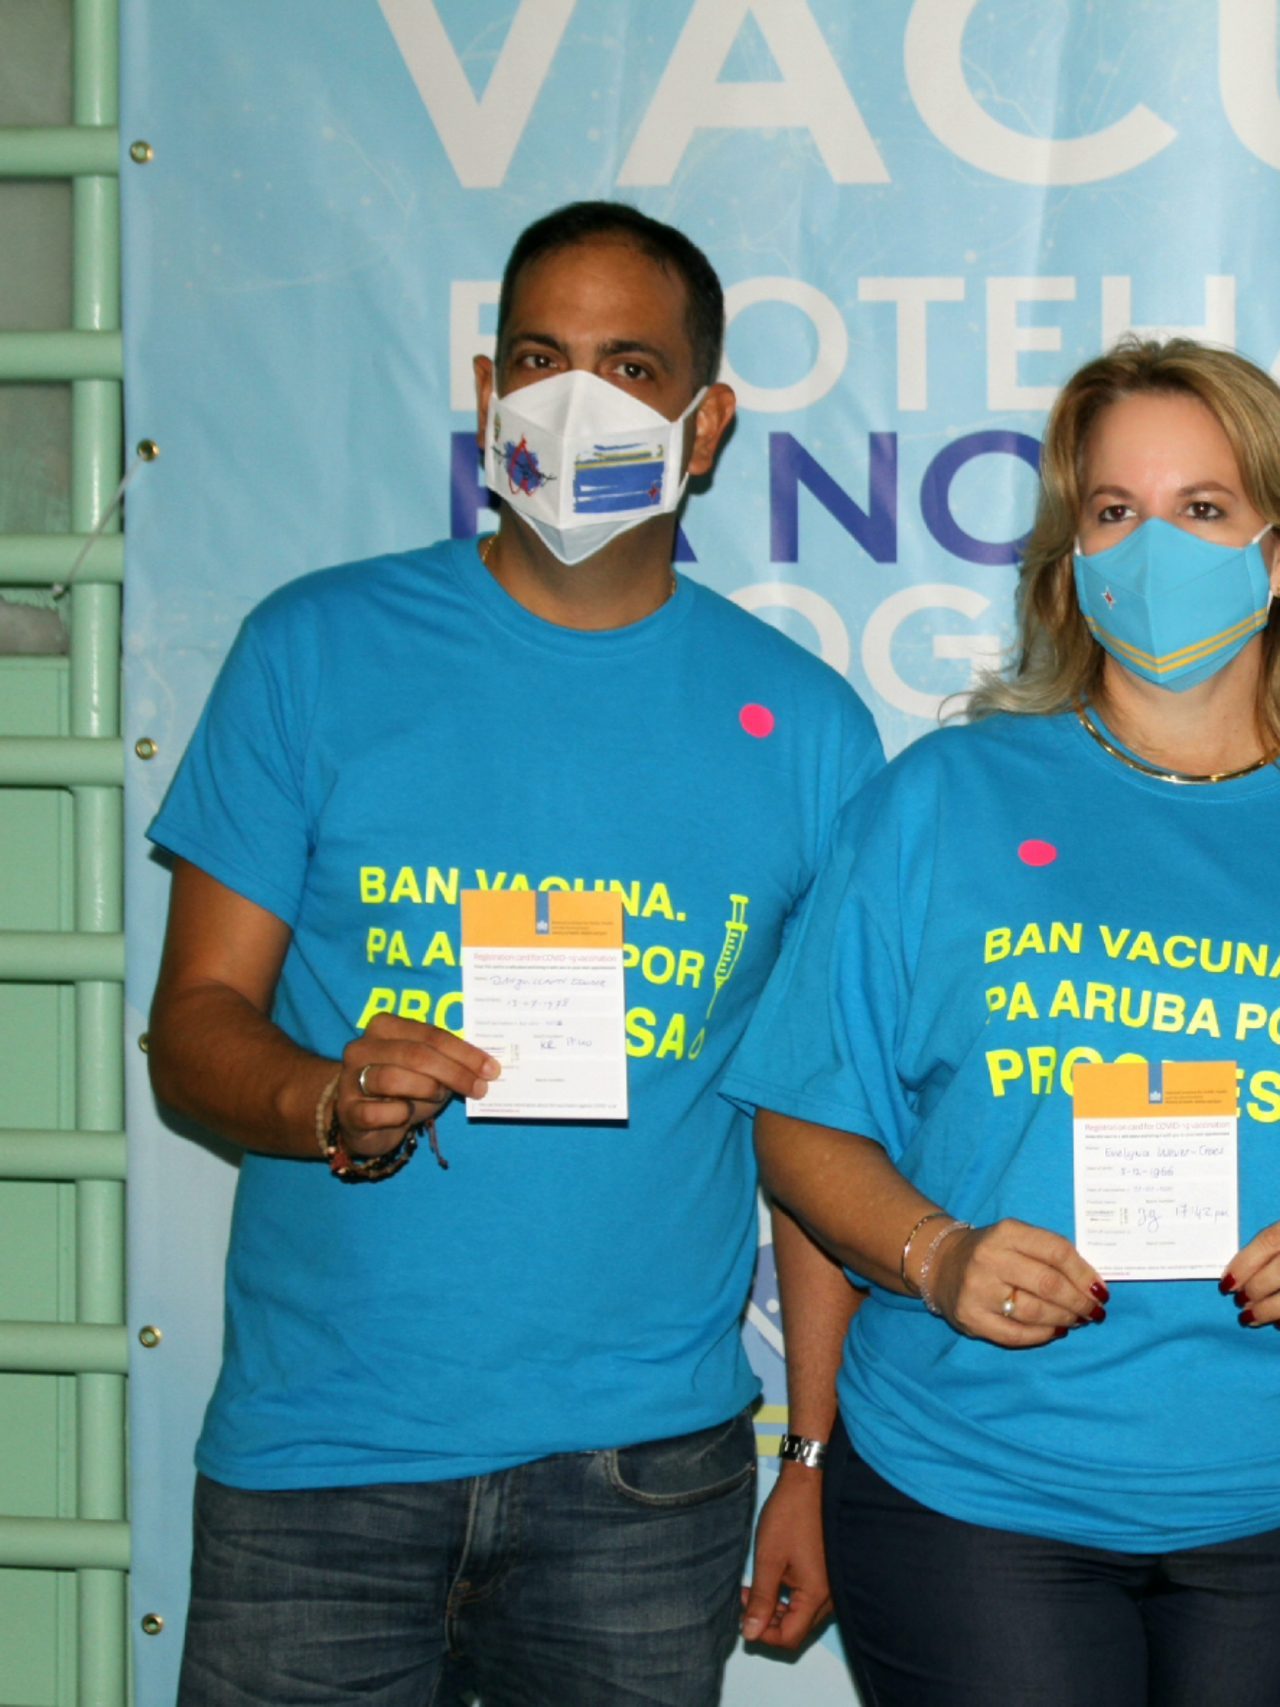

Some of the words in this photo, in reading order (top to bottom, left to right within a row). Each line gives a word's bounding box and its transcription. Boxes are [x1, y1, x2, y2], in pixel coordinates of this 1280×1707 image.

[769, 431, 1045, 565] NO
[360, 866, 459, 905] BAN
[366, 928, 412, 967] PA
[984, 922, 1083, 964] BAN
[356, 987, 686, 1060] PROSA
[985, 981, 1039, 1024] PA
[1048, 980, 1221, 1038] ARUBA
